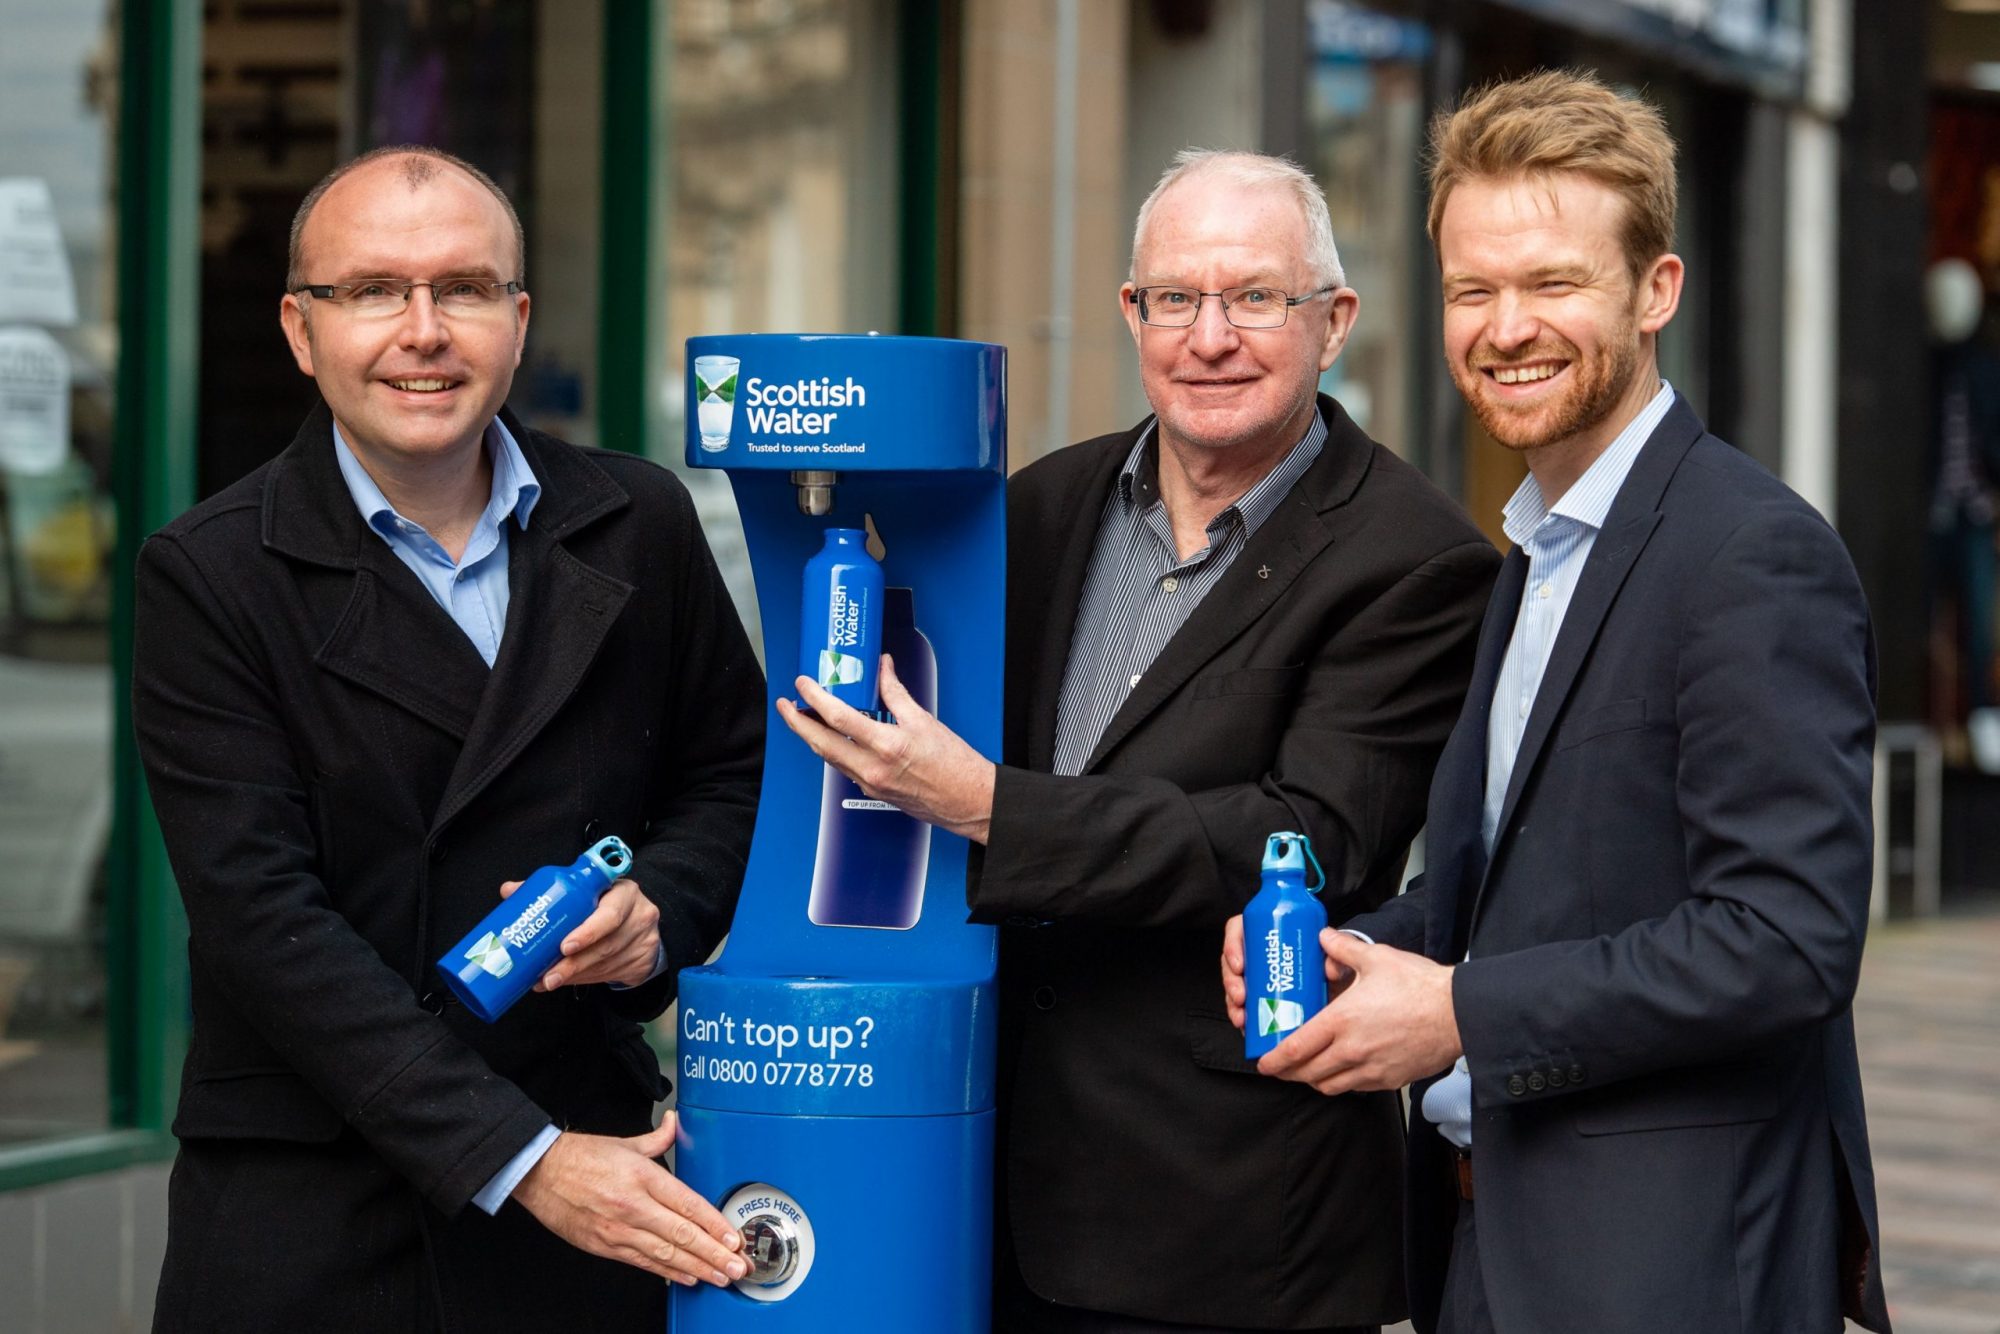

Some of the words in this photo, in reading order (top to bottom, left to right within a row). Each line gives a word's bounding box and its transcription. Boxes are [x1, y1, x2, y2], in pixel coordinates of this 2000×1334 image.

[746, 377, 865, 407] Scottish
[746, 407, 837, 434] Water
[747, 443, 780, 453] Trusted
[781, 444, 792, 453] to
[793, 445, 820, 453] serve
[822, 443, 865, 453] Scotland
[831, 586, 847, 646] Scottish
[844, 600, 859, 647] Water
[502, 895, 552, 940] Scottish
[510, 911, 550, 949] Water
[1265, 929, 1280, 993] Scottish
[1280, 943, 1294, 992] Water
[684, 1008, 736, 1045] Can't
[743, 1018, 799, 1058] top
[808, 1016, 875, 1060] up?
[684, 1054, 705, 1079] Call
[709, 1058, 757, 1084] 0800
[763, 1062, 874, 1088] 0778778
[737, 1197, 771, 1219] PRESS
[773, 1199, 802, 1225] HERE
